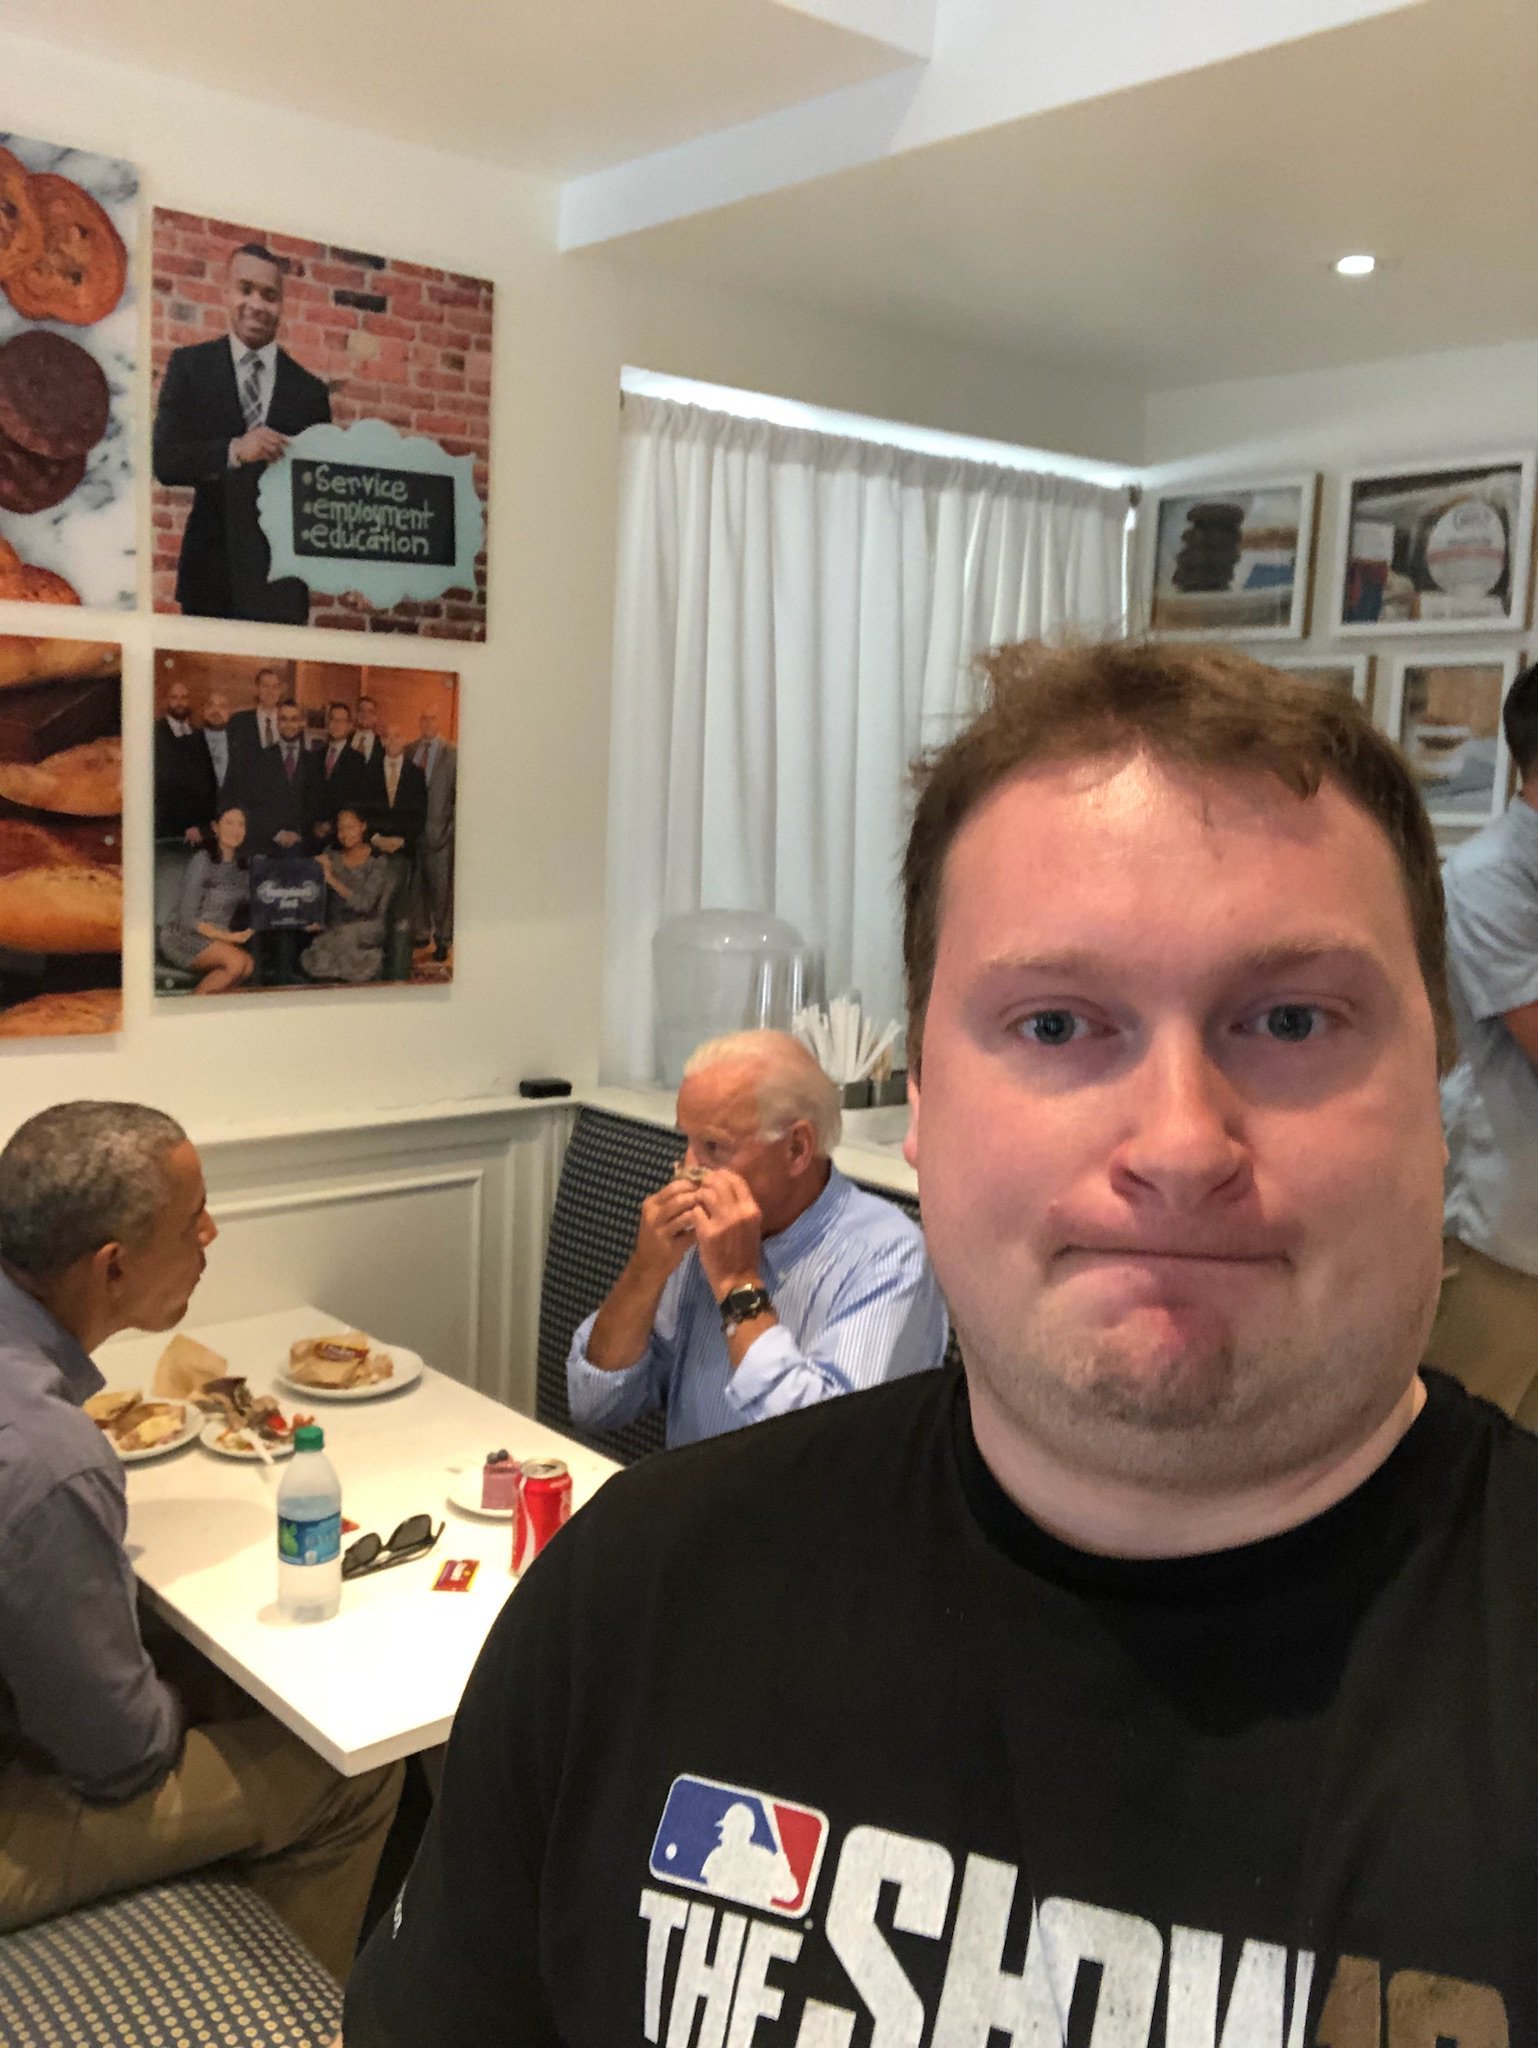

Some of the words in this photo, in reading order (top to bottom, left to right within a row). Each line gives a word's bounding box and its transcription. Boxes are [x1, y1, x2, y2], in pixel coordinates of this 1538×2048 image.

[315, 465, 408, 501] Service
[313, 498, 434, 532] employment
[310, 523, 430, 555] education
[638, 1887, 804, 2048] THE
